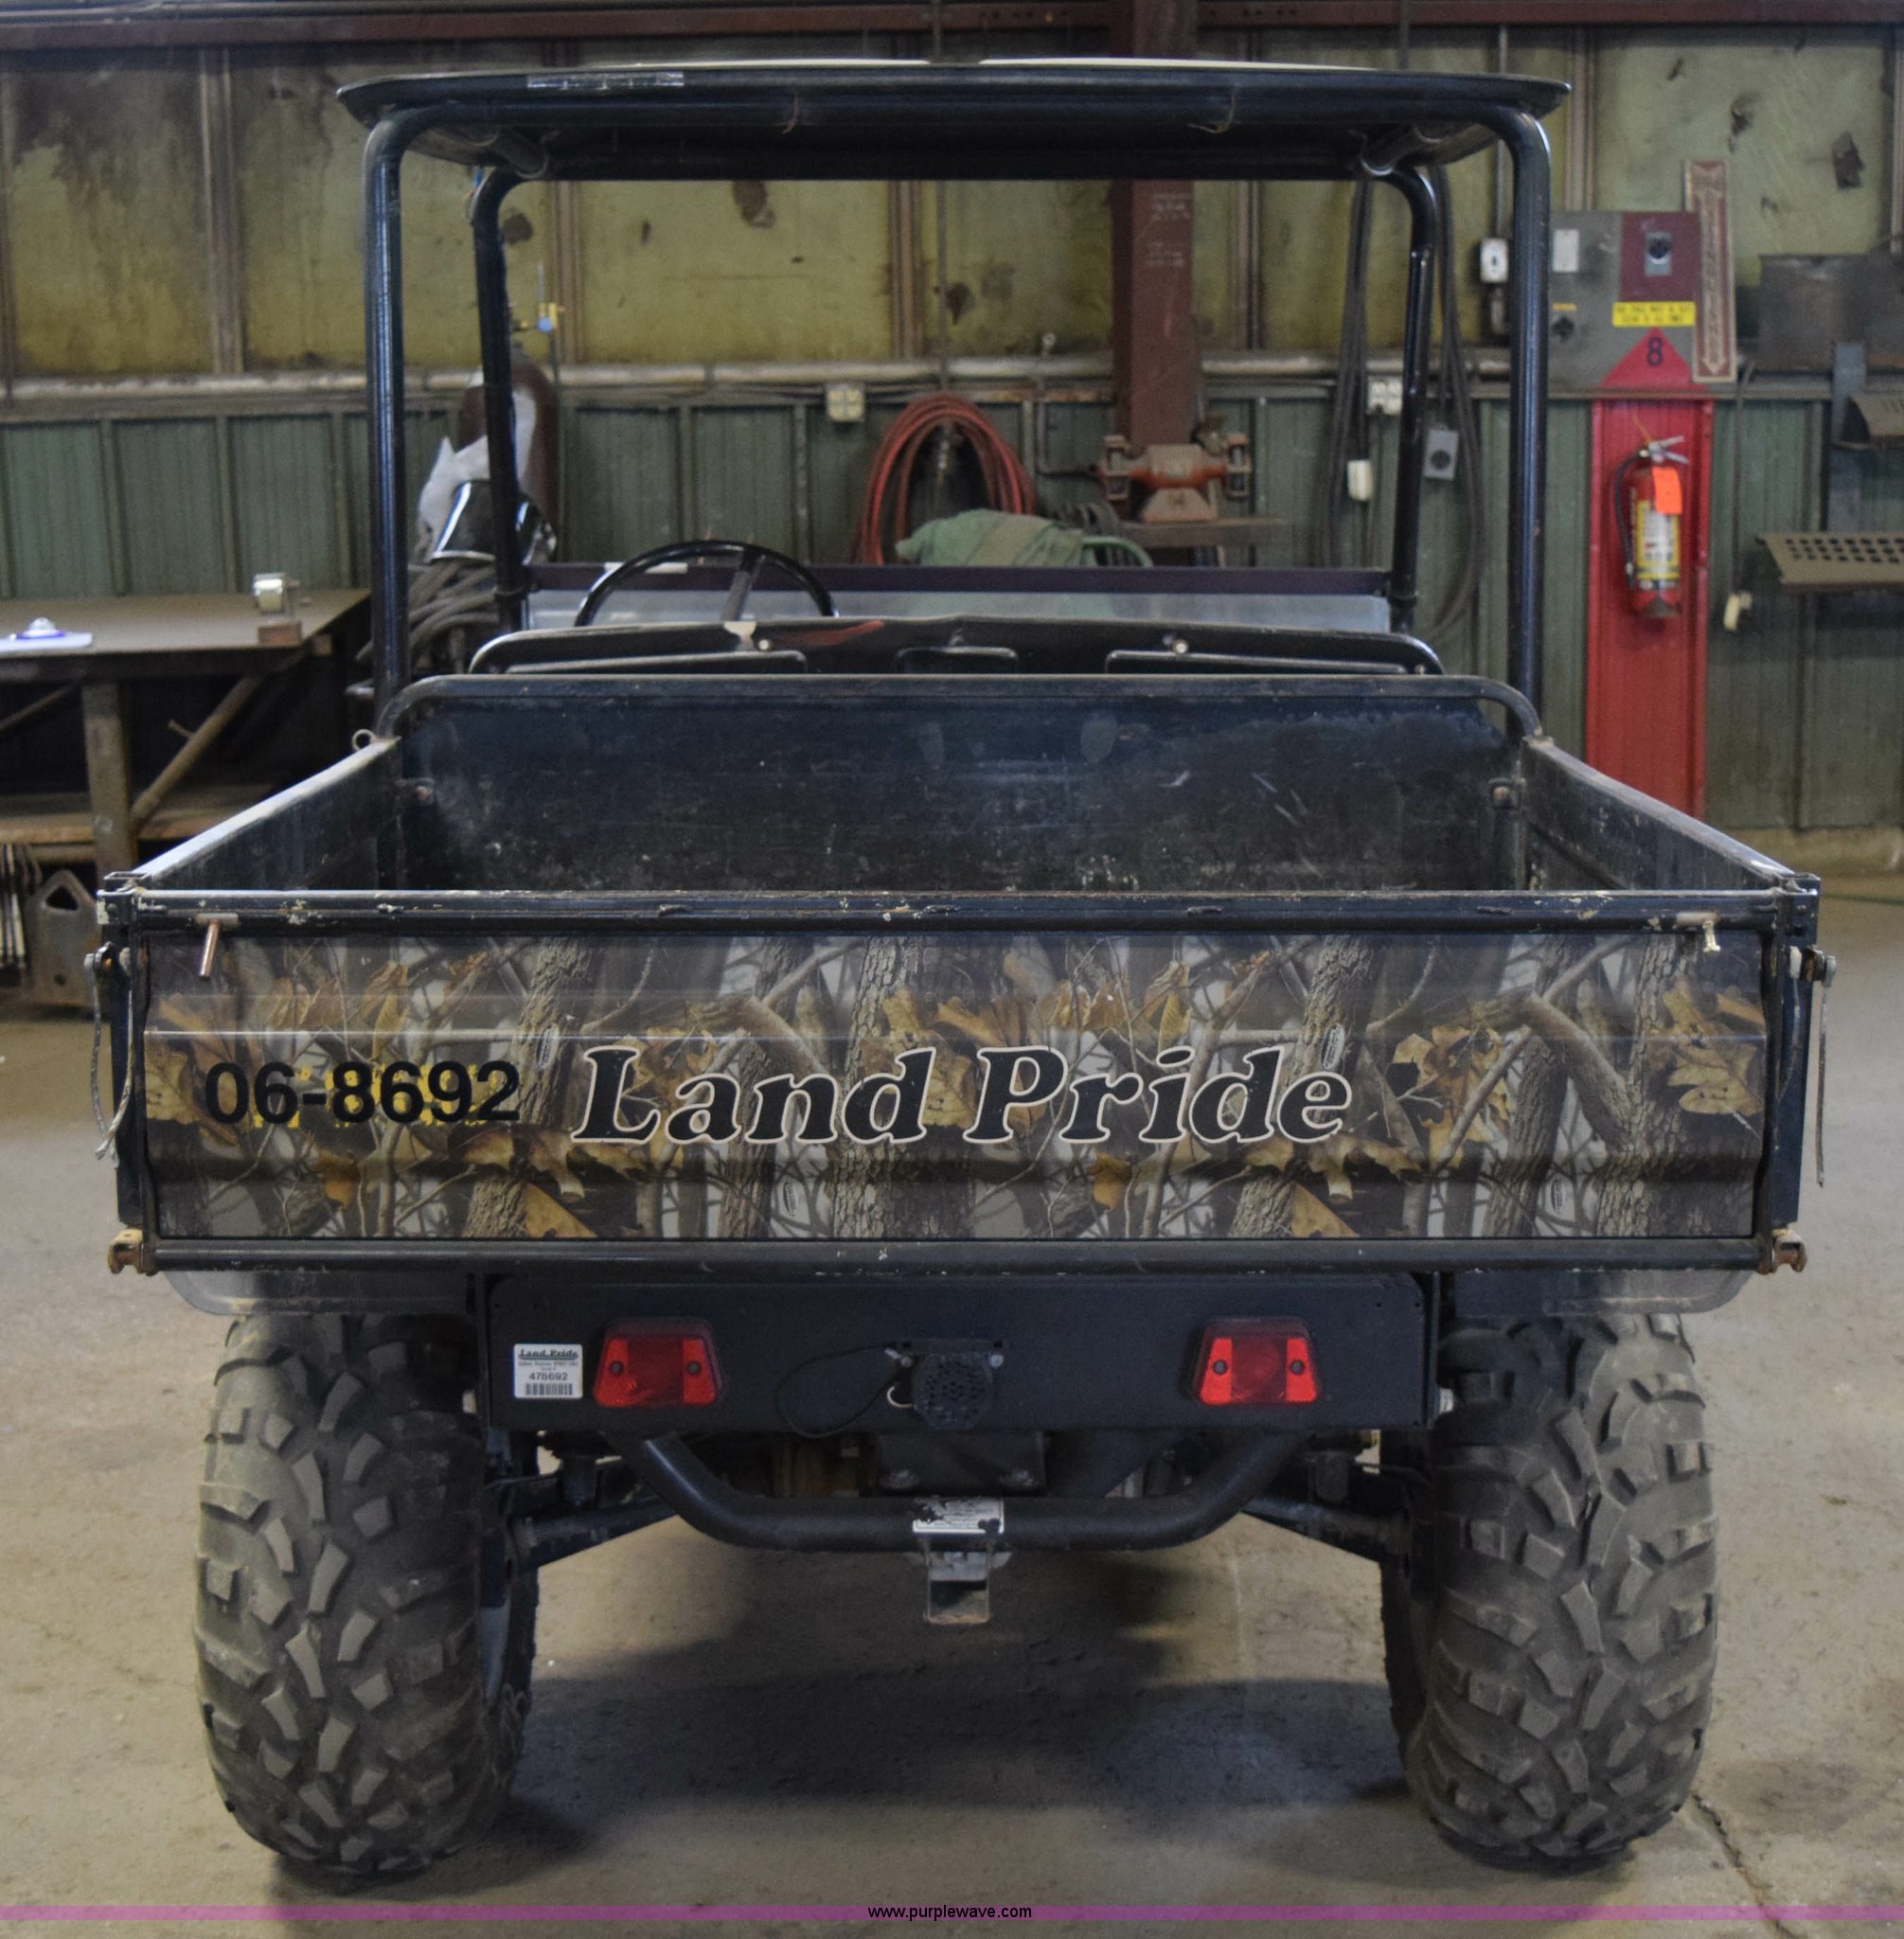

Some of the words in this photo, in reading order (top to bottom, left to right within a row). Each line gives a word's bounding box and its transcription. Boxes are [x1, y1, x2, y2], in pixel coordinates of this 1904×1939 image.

[1646, 337, 1664, 366] 8
[205, 1061, 520, 1124] 06-8692
[571, 1045, 935, 1145] Land
[963, 1045, 1352, 1145] Pride
[528, 1372, 568, 1380] 478692
